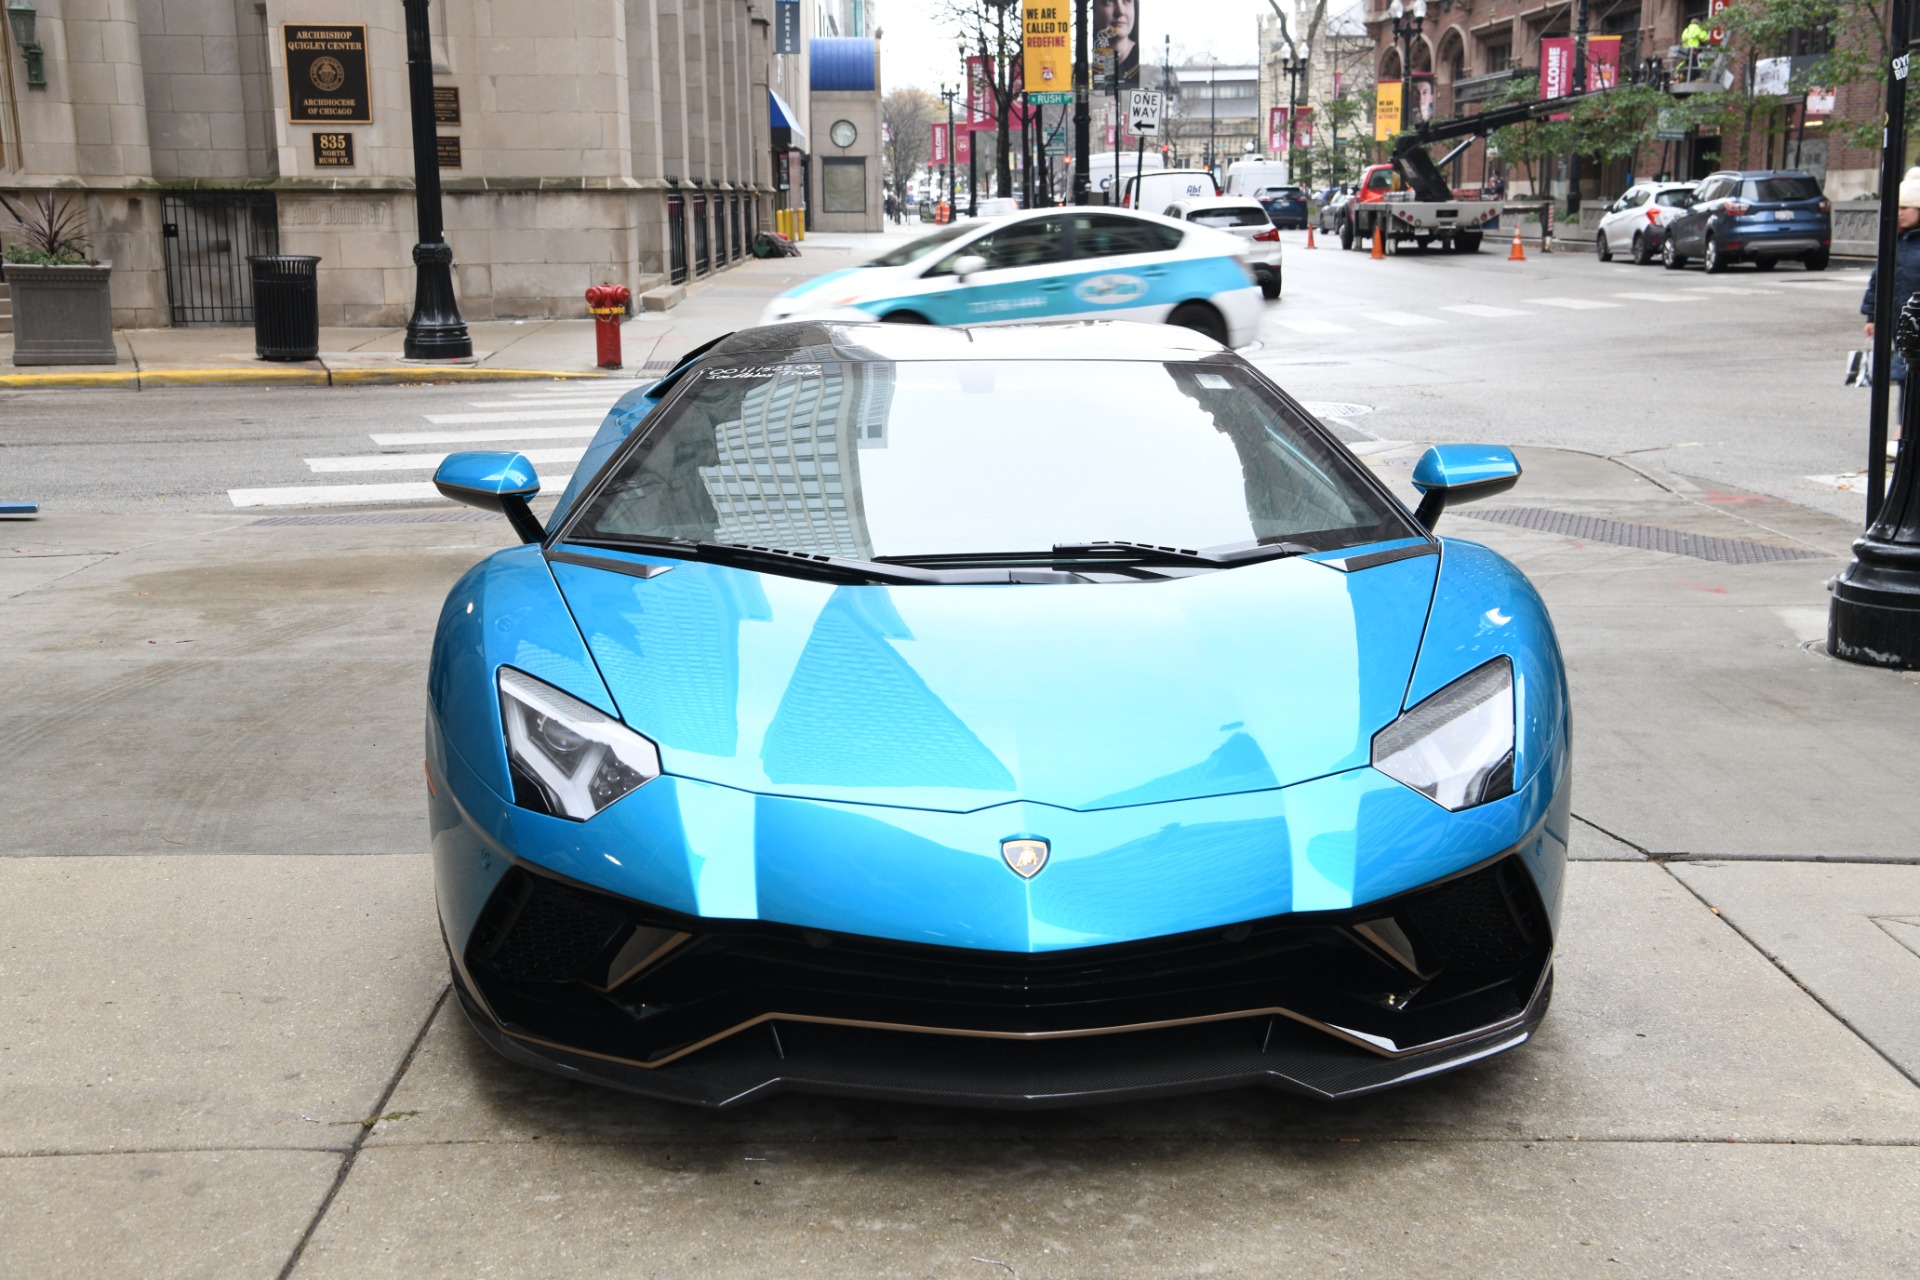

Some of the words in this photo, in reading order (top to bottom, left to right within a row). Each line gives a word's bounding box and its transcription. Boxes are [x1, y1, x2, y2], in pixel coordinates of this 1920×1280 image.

[1026, 8, 1039, 19] WE
[1041, 8, 1056, 19] ARE
[1026, 22, 1055, 33] CALLED
[1057, 22, 1068, 33] TO
[296, 31, 352, 39] ARCHBISHOP
[288, 42, 326, 50] QUIGLEY
[327, 42, 362, 50] CENTER
[1027, 36, 1065, 48] REDEFINE
[1547, 47, 1560, 99] ELCOME
[973, 63, 984, 123] WELCOME
[1037, 94, 1062, 105] RUSH
[1134, 94, 1158, 106] ONE
[1132, 107, 1158, 118] WAY
[320, 135, 346, 148] 835
